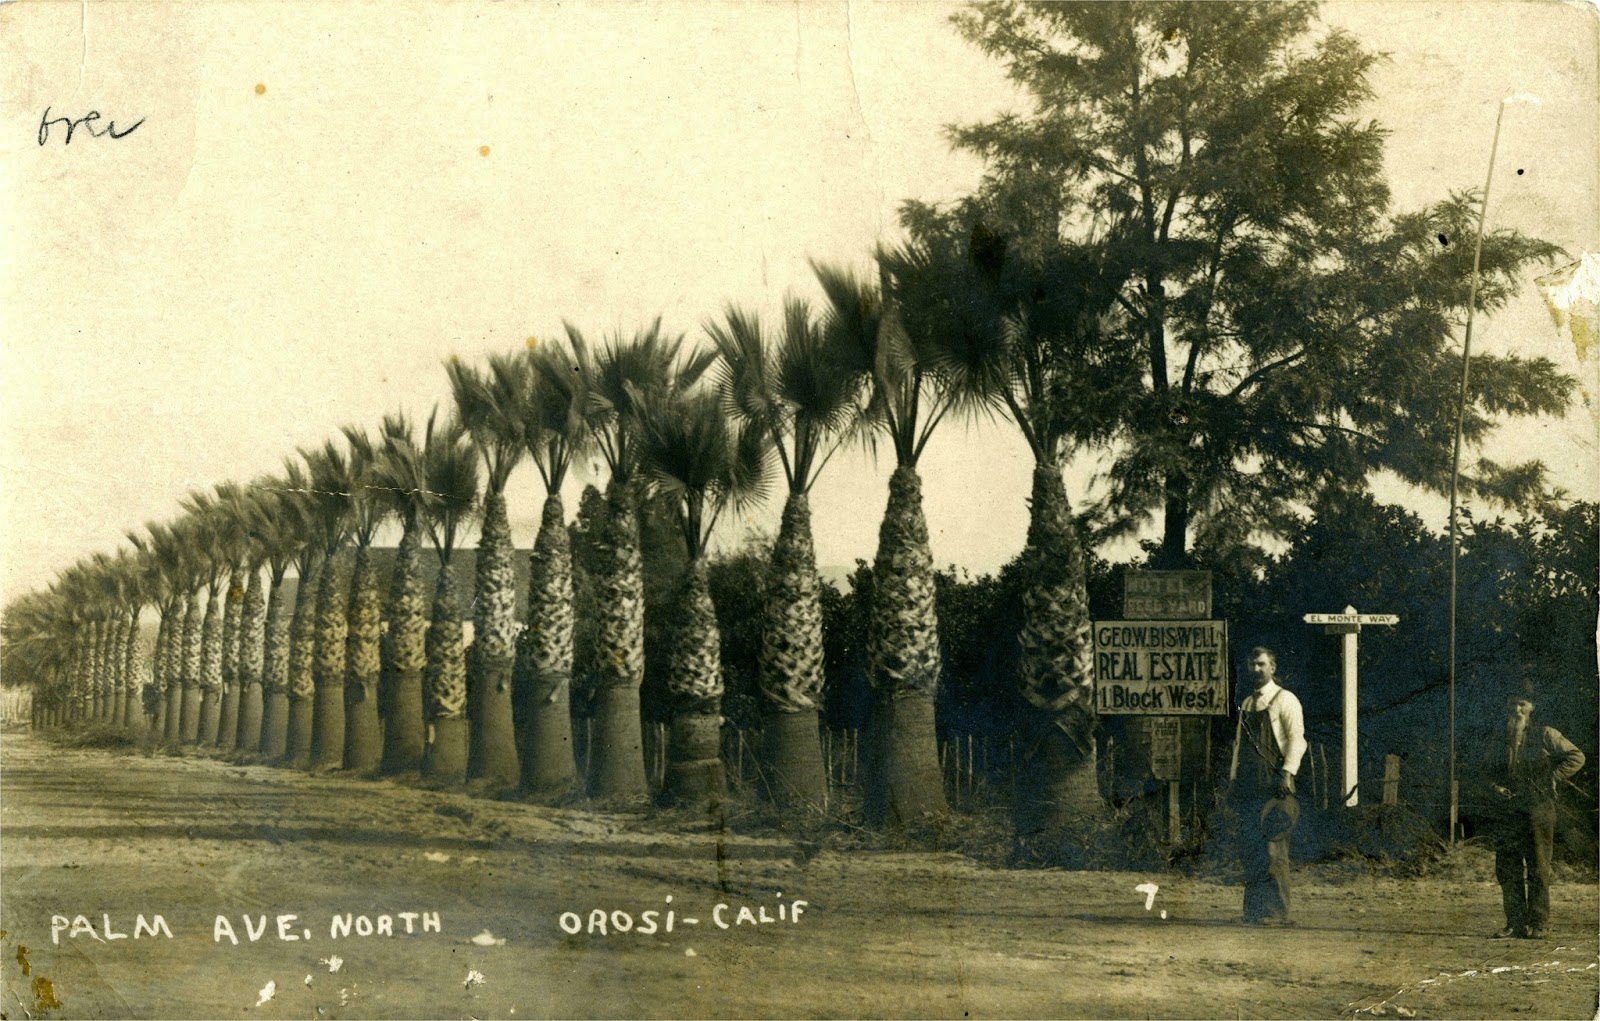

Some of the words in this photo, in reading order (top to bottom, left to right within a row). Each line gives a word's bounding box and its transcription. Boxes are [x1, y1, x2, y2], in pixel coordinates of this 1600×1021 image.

[1328, 615, 1362, 623] MONTE
[1098, 652, 1143, 680] REAL
[1149, 652, 1219, 681] ESTATE
[1101, 686, 1107, 708] 1
[1112, 685, 1163, 708] Block
[1167, 685, 1220, 708] West.
